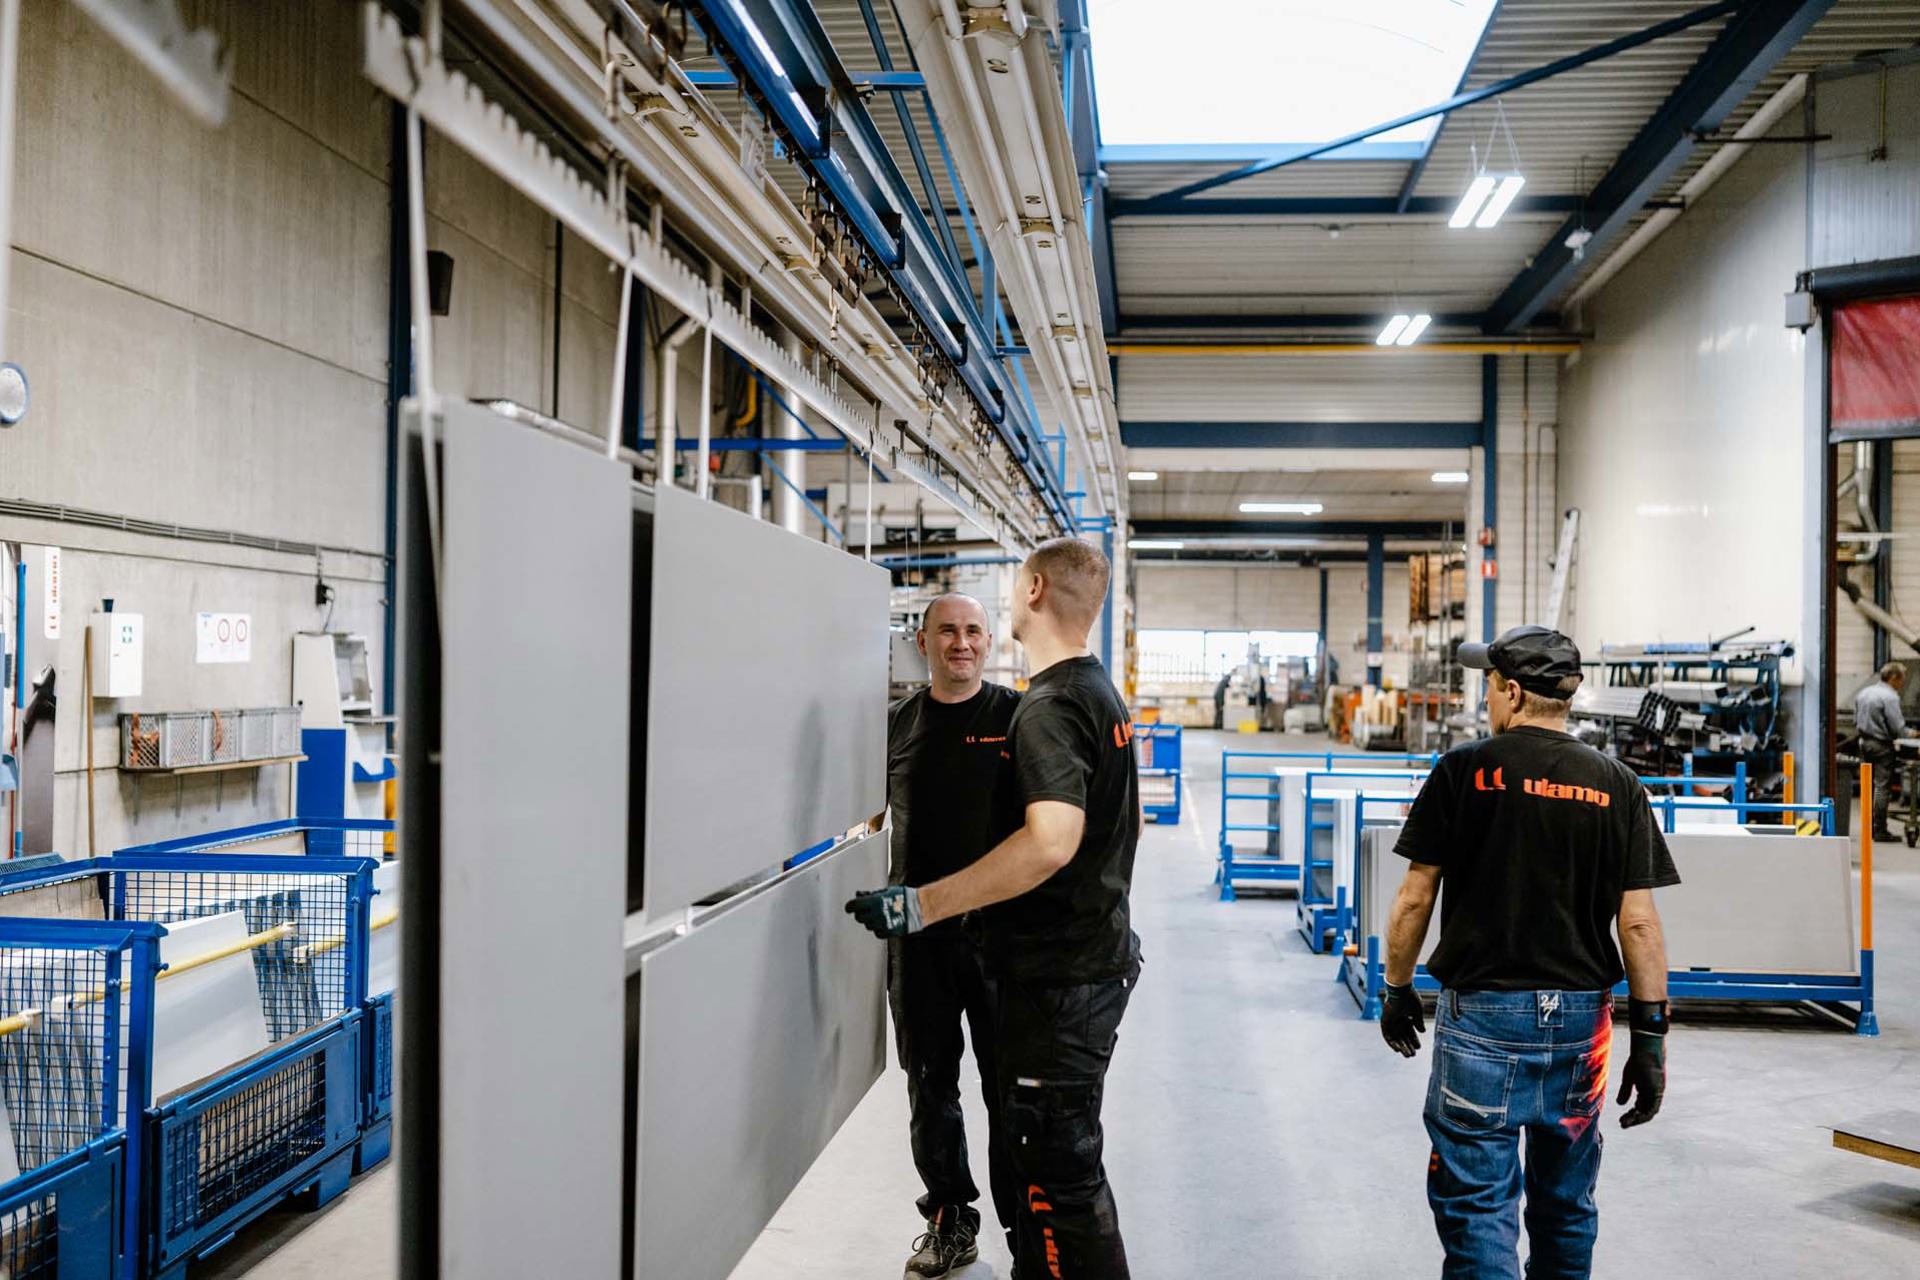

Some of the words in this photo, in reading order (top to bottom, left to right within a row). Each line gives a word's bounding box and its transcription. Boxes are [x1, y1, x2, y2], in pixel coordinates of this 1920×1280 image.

[1523, 777, 1611, 808] ulamo
[1540, 993, 1560, 1010] 24
[1543, 1006, 1554, 1023] 7
